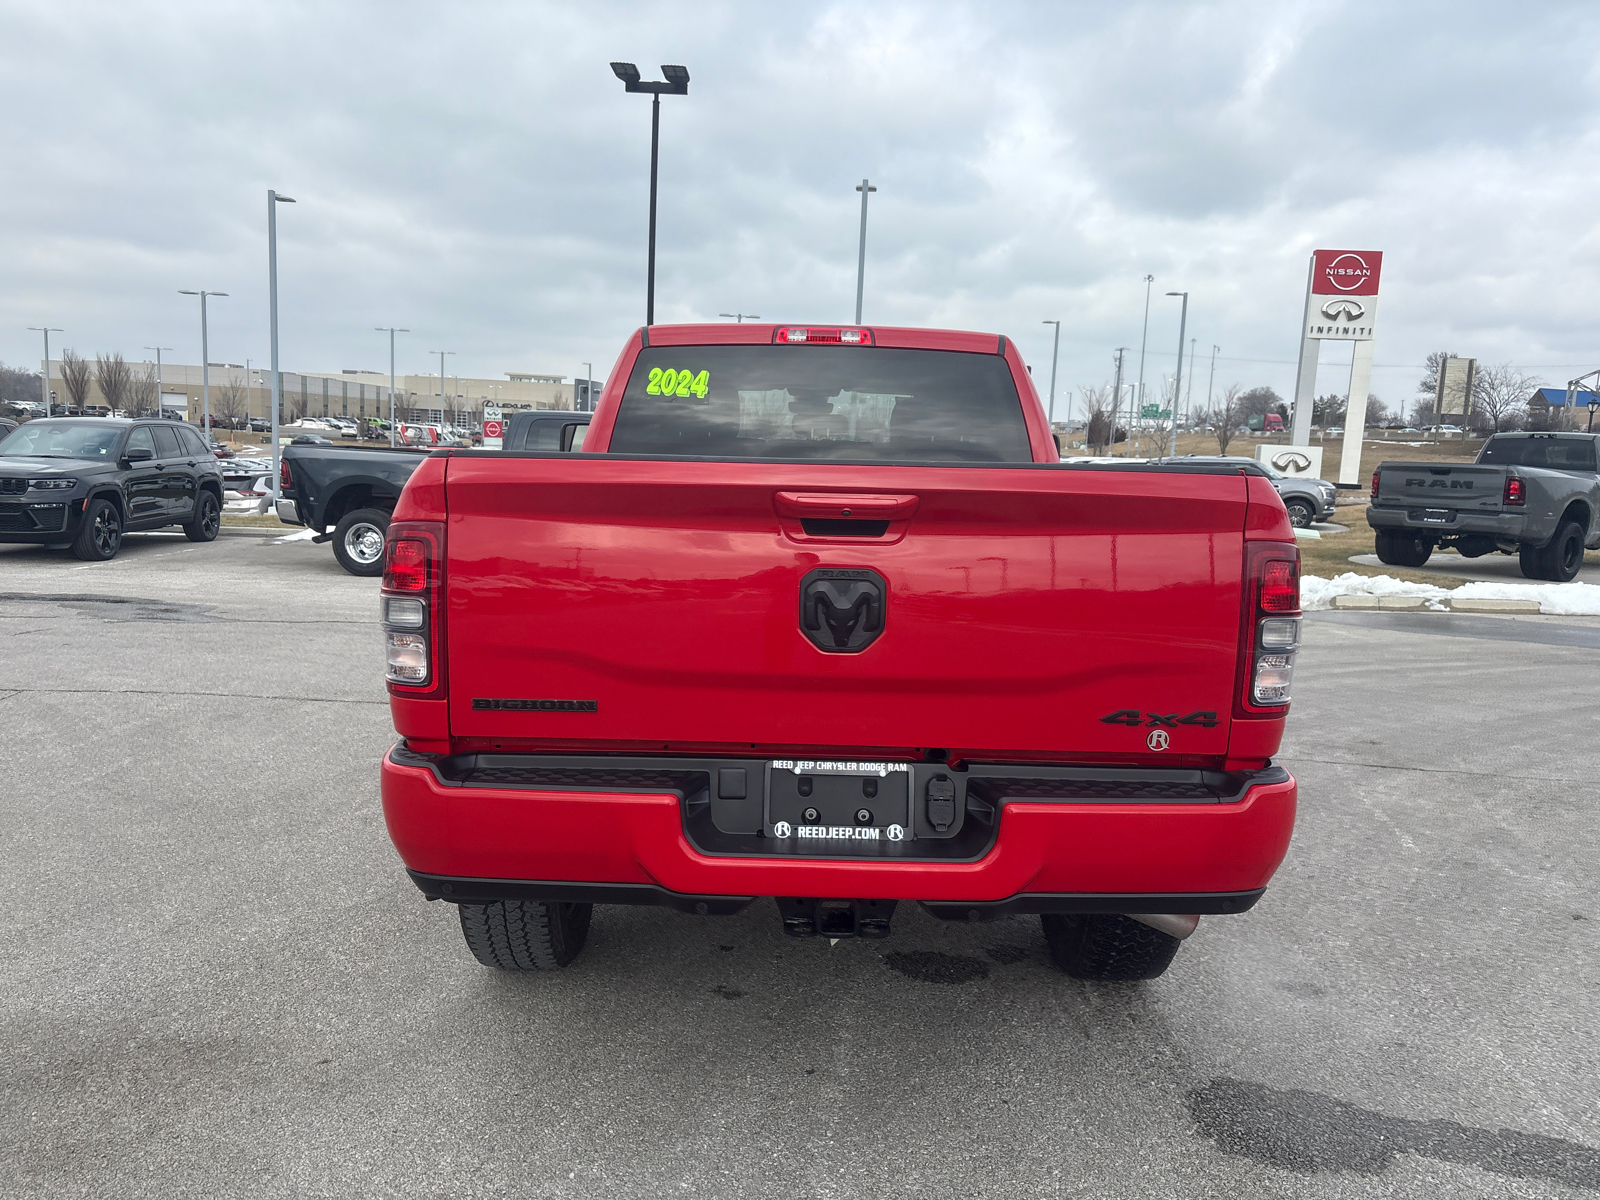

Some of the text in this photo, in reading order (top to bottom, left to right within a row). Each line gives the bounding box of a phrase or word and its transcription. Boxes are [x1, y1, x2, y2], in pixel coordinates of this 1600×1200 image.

[1326, 268, 1370, 276] NISSAN
[1310, 326, 1372, 335] INFINITI
[646, 367, 710, 398] 2024
[496, 402, 532, 411] LEXUS
[1405, 478, 1474, 489] RAM
[817, 570, 869, 578] RAM
[472, 698, 597, 713] BIGHORN
[1099, 709, 1222, 728] 4x4
[1147, 730, 1170, 751] R
[773, 760, 907, 772] REED JEEP CHRYSLER DODGE RAM
[775, 821, 904, 841] R REEDJEEP.COM R
